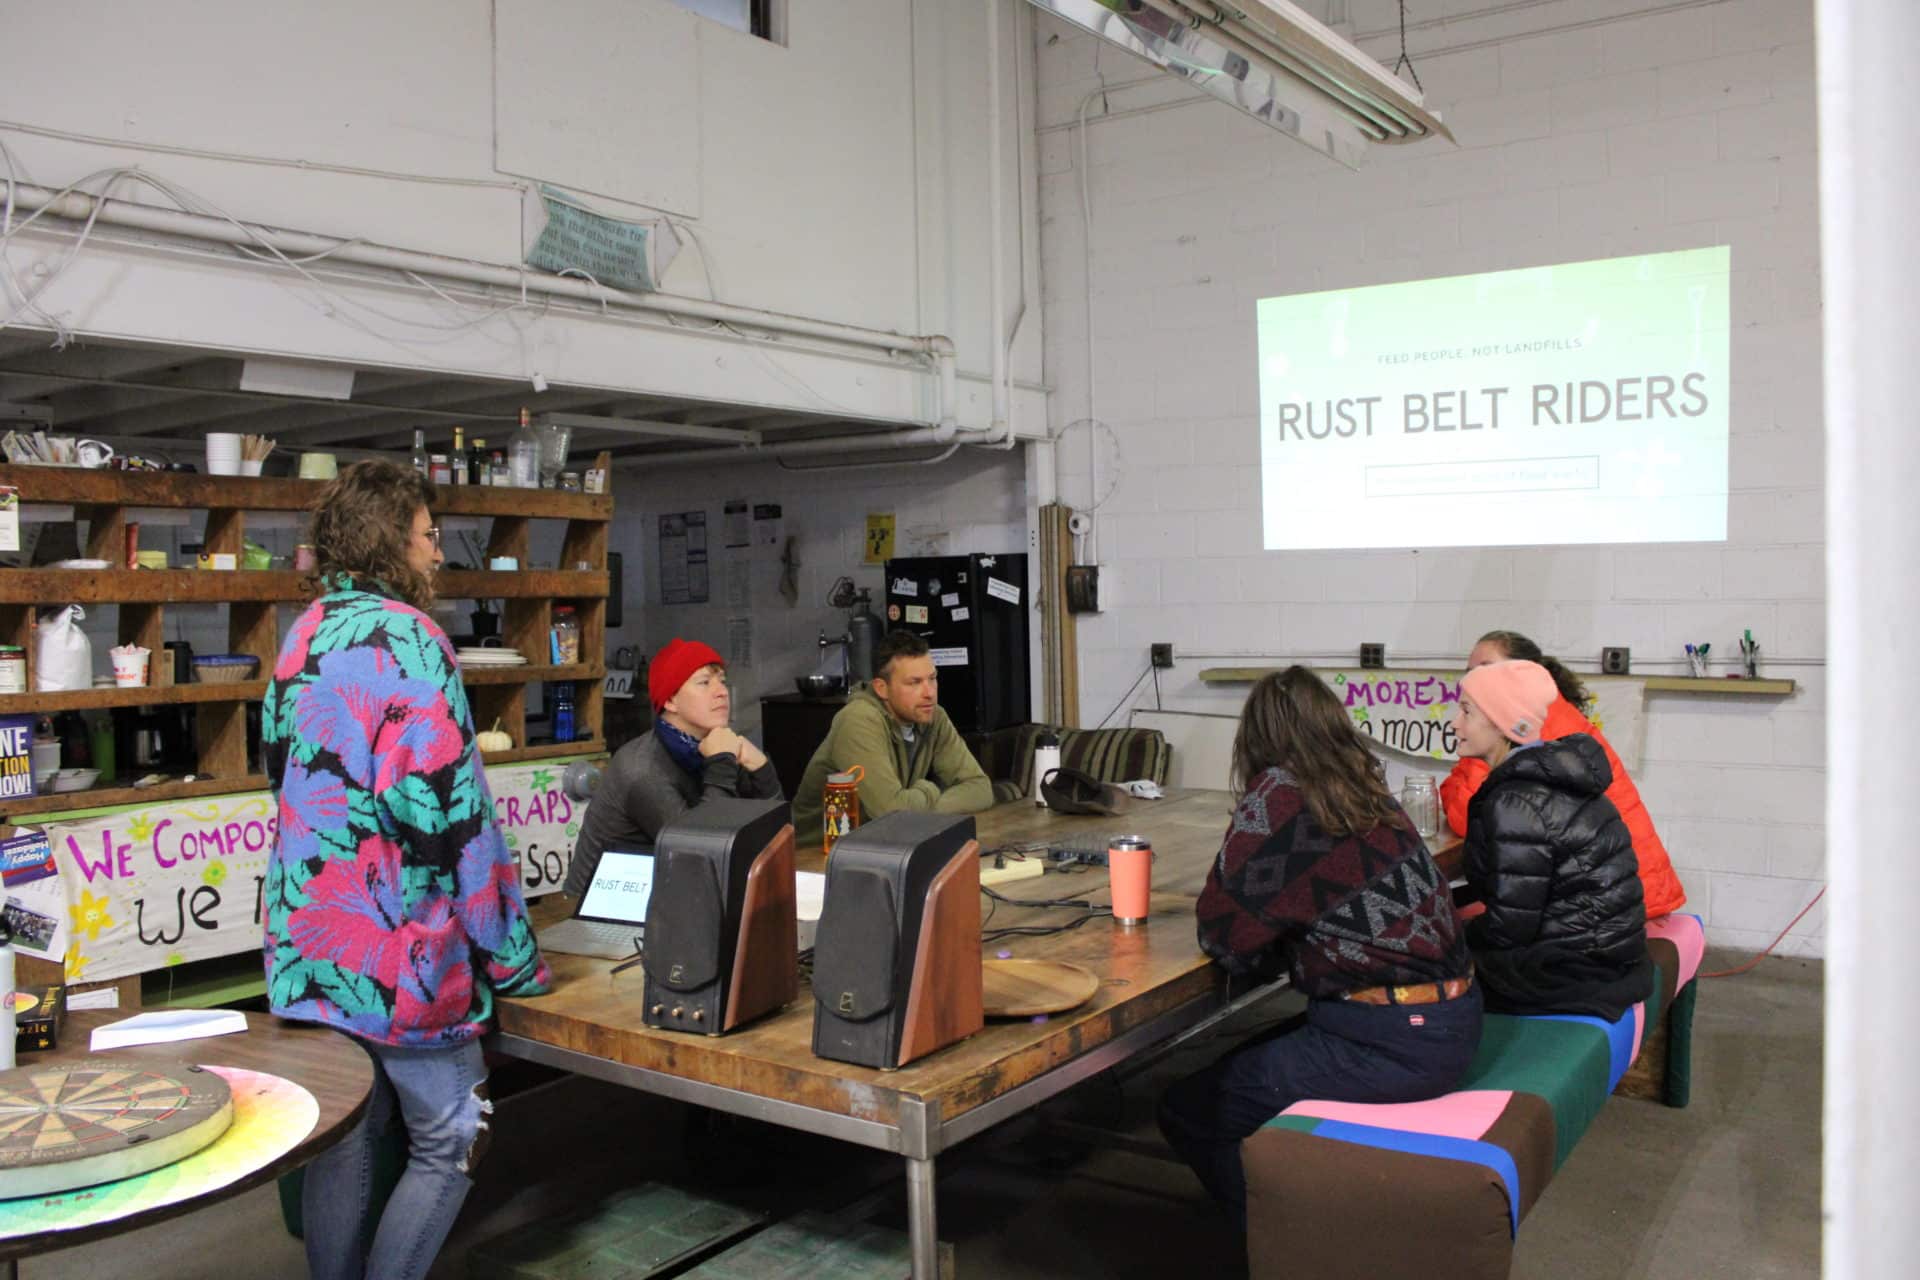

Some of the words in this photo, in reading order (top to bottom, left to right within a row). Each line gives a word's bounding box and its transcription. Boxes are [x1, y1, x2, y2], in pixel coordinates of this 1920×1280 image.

[1377, 352, 1409, 364] FEED
[1472, 344, 1501, 357] NOT
[1505, 337, 1583, 354] LANDFILLS
[1278, 397, 1382, 441] RUST
[1403, 387, 1509, 433] BELT
[1531, 372, 1709, 426] RIDERS
[1381, 718, 1458, 754] more
[0, 773, 32, 795] OW!
[594, 878, 620, 891] RUST
[622, 880, 648, 894] BELT
